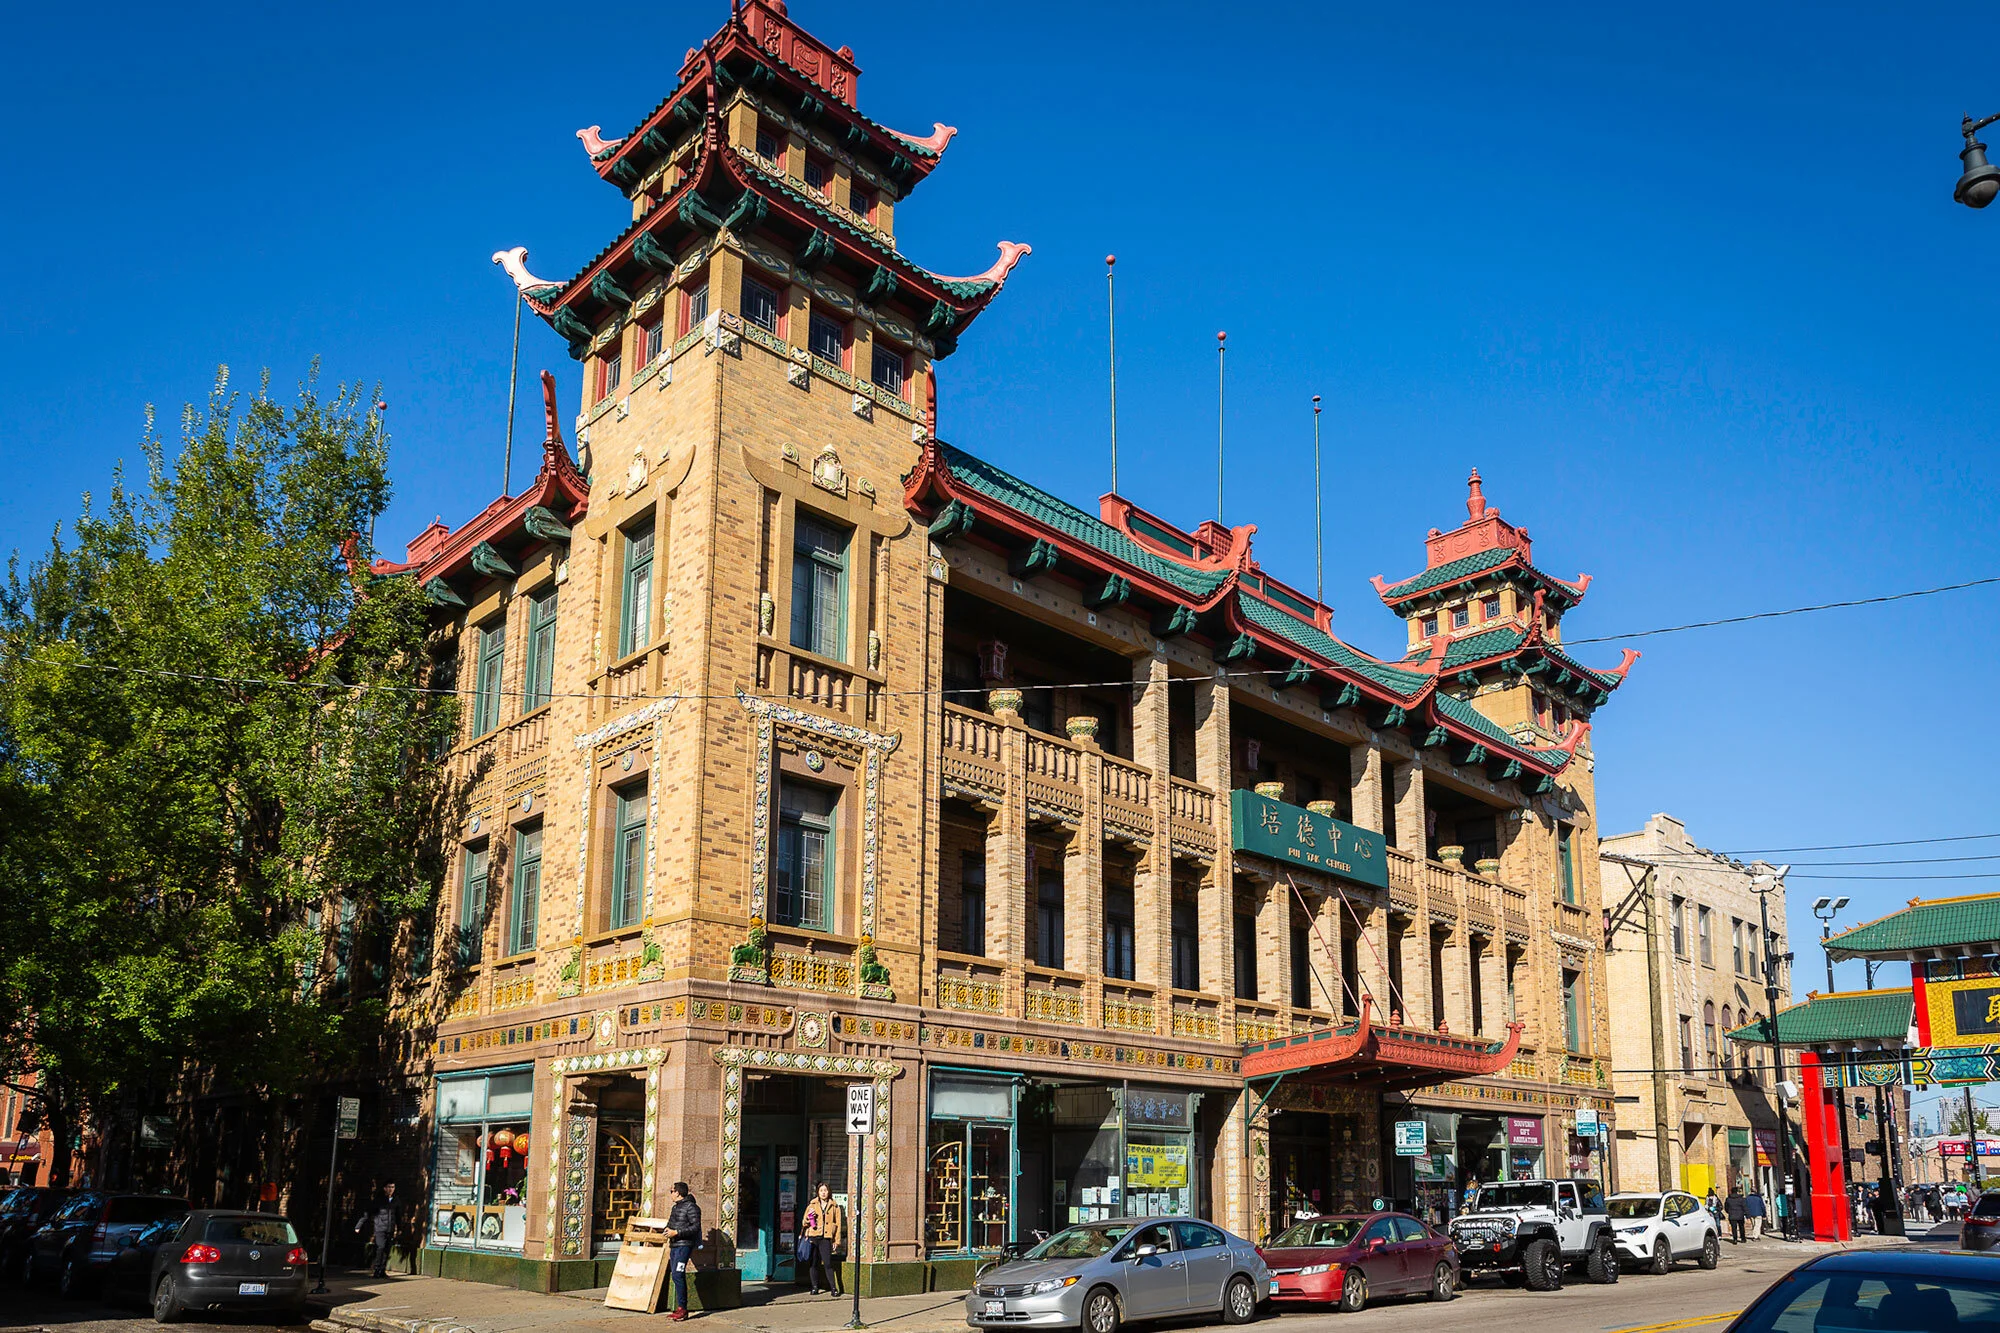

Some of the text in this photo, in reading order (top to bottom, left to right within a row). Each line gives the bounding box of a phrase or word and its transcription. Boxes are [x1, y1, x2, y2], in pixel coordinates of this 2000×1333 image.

[1260, 803, 1373, 859] 培德中心
[1288, 847, 1351, 872] PUI TAK CENTER
[851, 1090, 869, 1101] ONE
[850, 1103, 869, 1114] WAY
